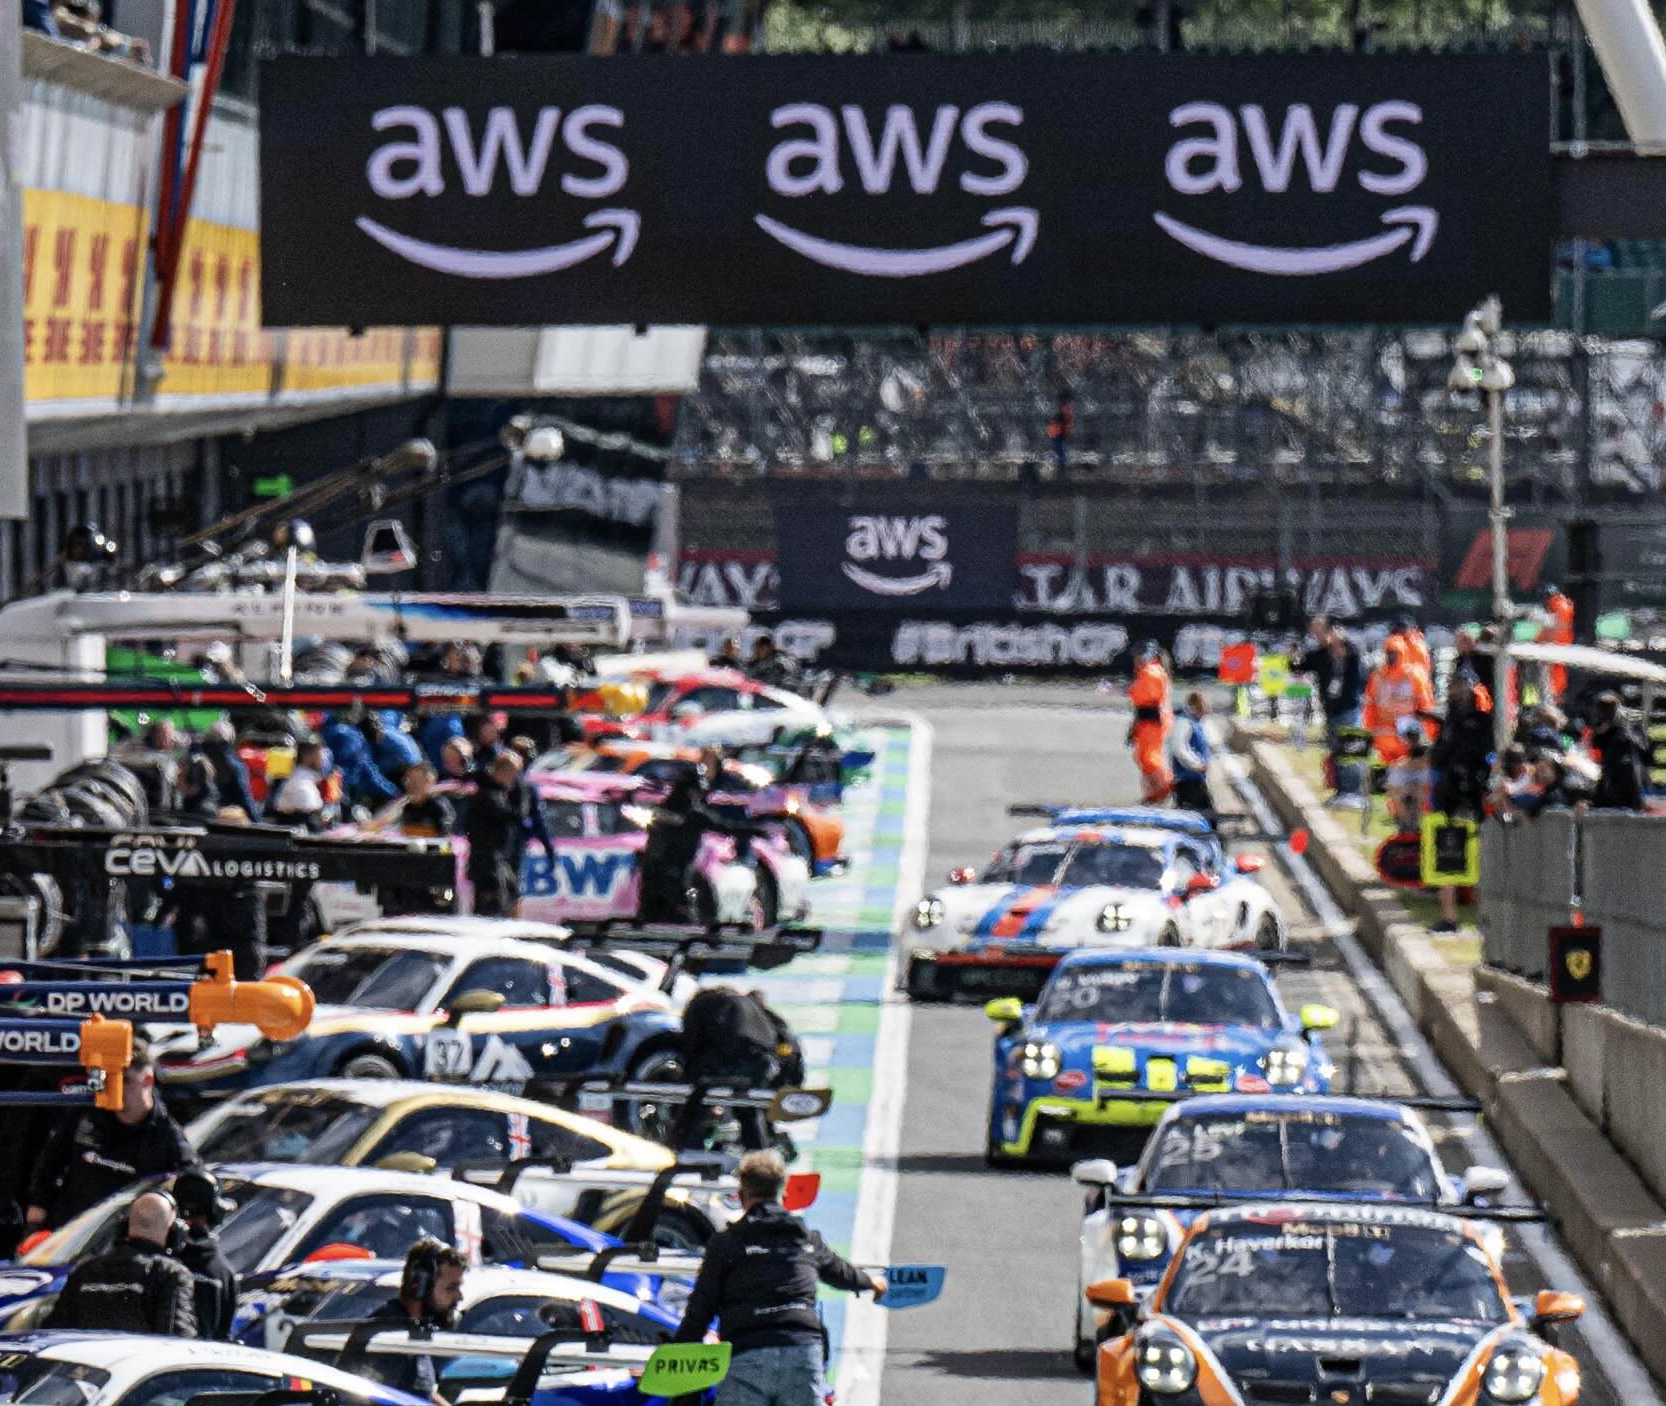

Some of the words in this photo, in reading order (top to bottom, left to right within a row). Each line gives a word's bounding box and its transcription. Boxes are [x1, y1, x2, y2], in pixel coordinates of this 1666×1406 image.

[366, 104, 630, 200] aws
[766, 102, 1028, 198] aws
[1165, 100, 1427, 198] aws
[846, 515, 948, 560] aws
[213, 861, 321, 879] LOGISTICS
[47, 993, 85, 1013] DP
[89, 993, 189, 1013] WORLD
[655, 1357, 720, 1375] PRIVAS
